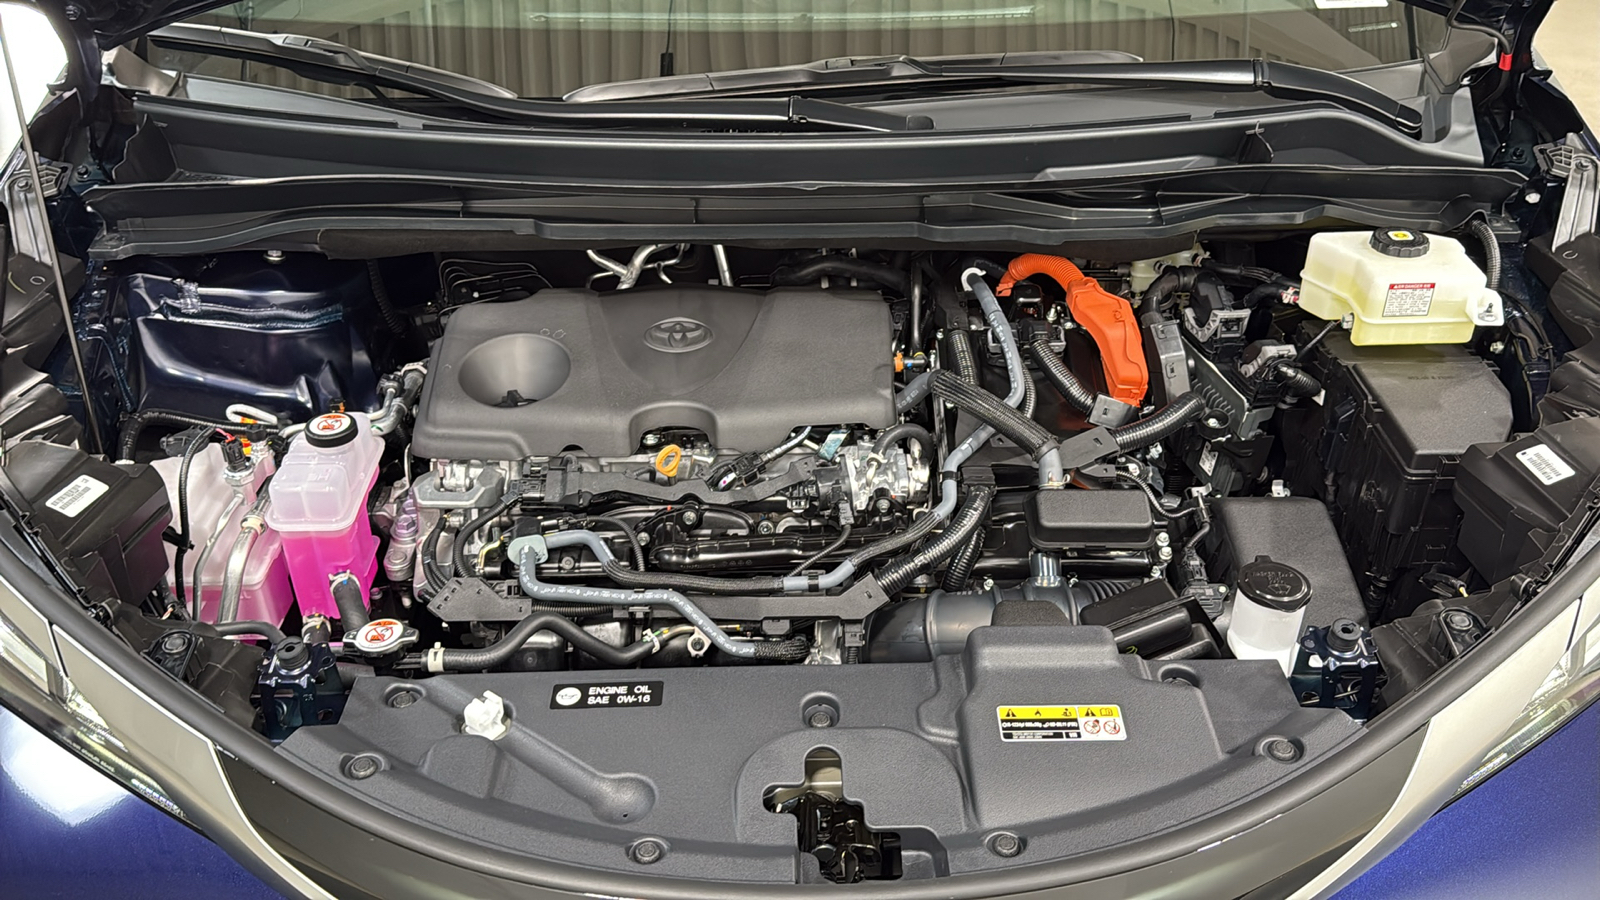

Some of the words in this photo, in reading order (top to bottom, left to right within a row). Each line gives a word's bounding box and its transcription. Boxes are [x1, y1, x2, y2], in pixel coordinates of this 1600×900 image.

[588, 686, 628, 695] ENGINE
[634, 685, 652, 693] OIL
[587, 696, 610, 704] SAE
[616, 694, 651, 704] 0W-16
